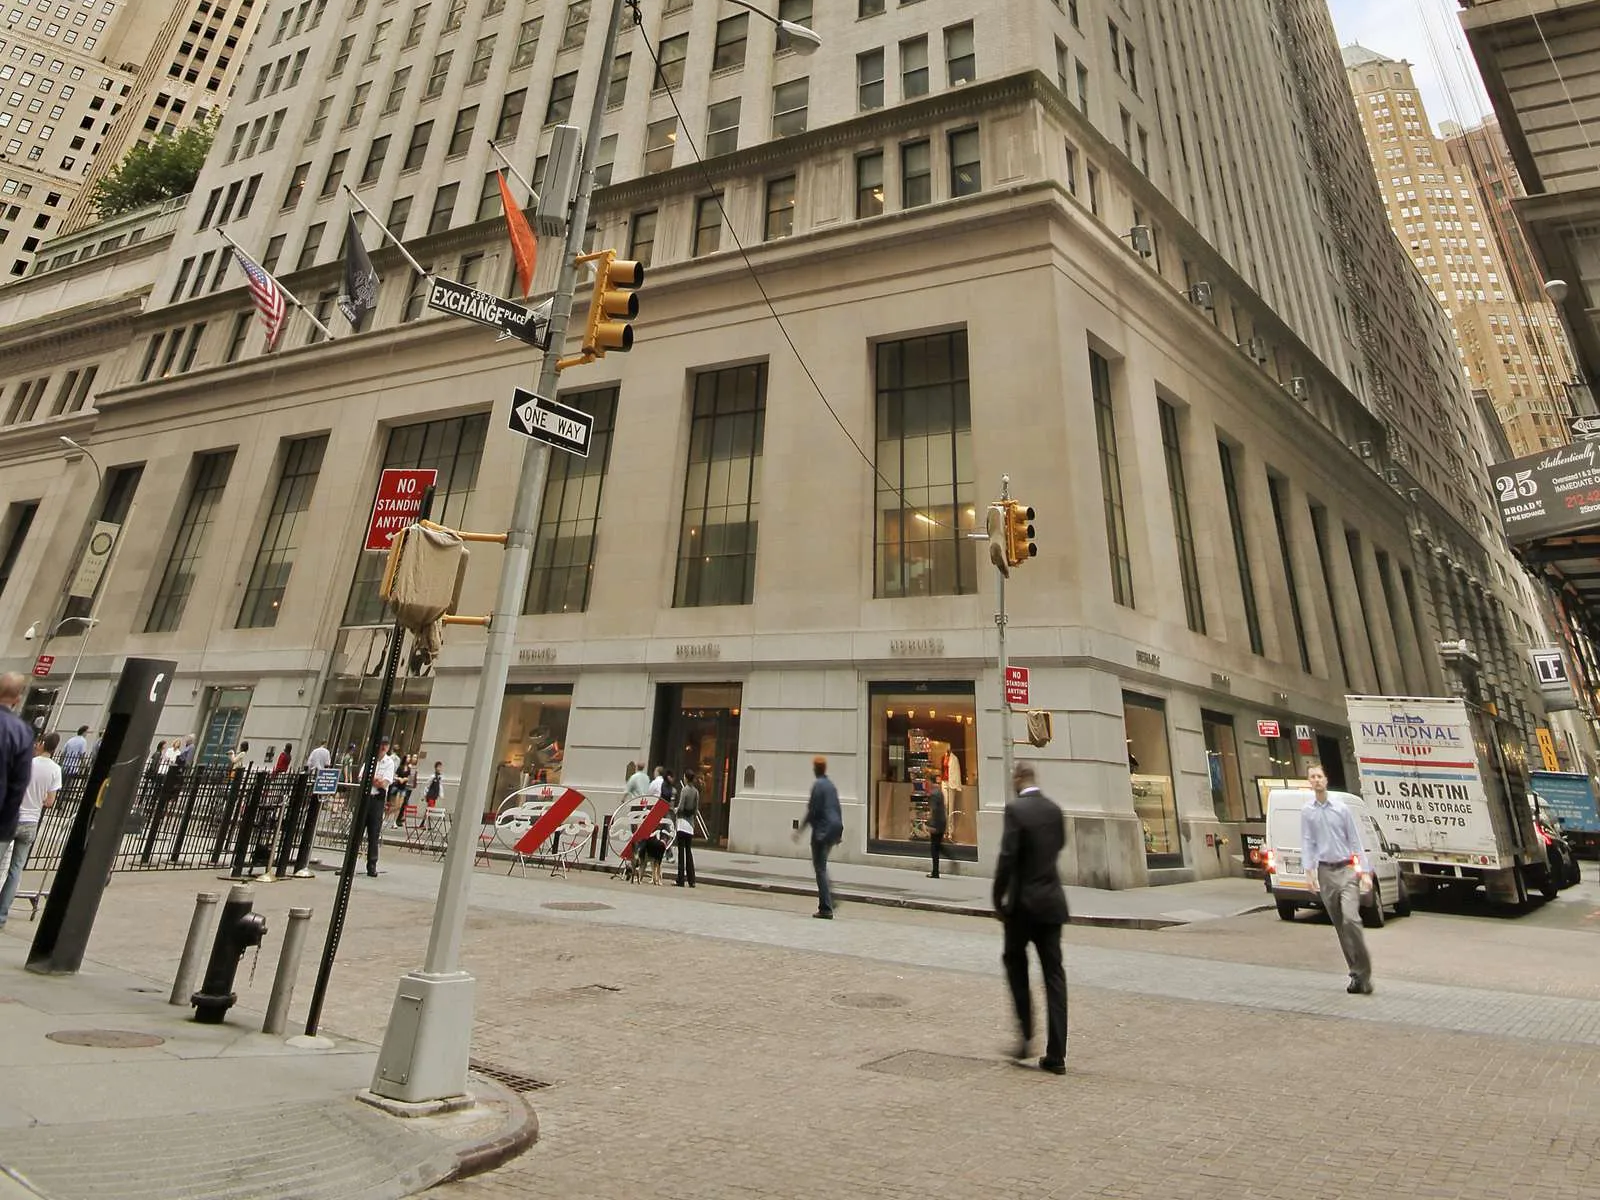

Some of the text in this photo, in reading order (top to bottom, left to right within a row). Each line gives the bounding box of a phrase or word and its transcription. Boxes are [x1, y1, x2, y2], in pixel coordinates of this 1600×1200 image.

[431, 286, 526, 326] EXCHANGE PLACE
[477, 292, 497, 305] 59-70
[524, 406, 582, 440] ONE WAY
[1577, 421, 1594, 429] ONE
[1537, 442, 1595, 470] Authentically
[397, 478, 416, 493] NO
[1496, 469, 1537, 502] 25
[1555, 477, 1593, 493] IMMEDIATE
[377, 499, 421, 511] STANDIN
[1503, 502, 1535, 515] BROAD
[1013, 671, 1021, 679] NO
[1361, 724, 1460, 740] NATIONAL
[1374, 781, 1469, 800] U. SANTINI
[1377, 799, 1472, 814] MOVING & STORAGE
[1401, 813, 1466, 827] 768-6778
